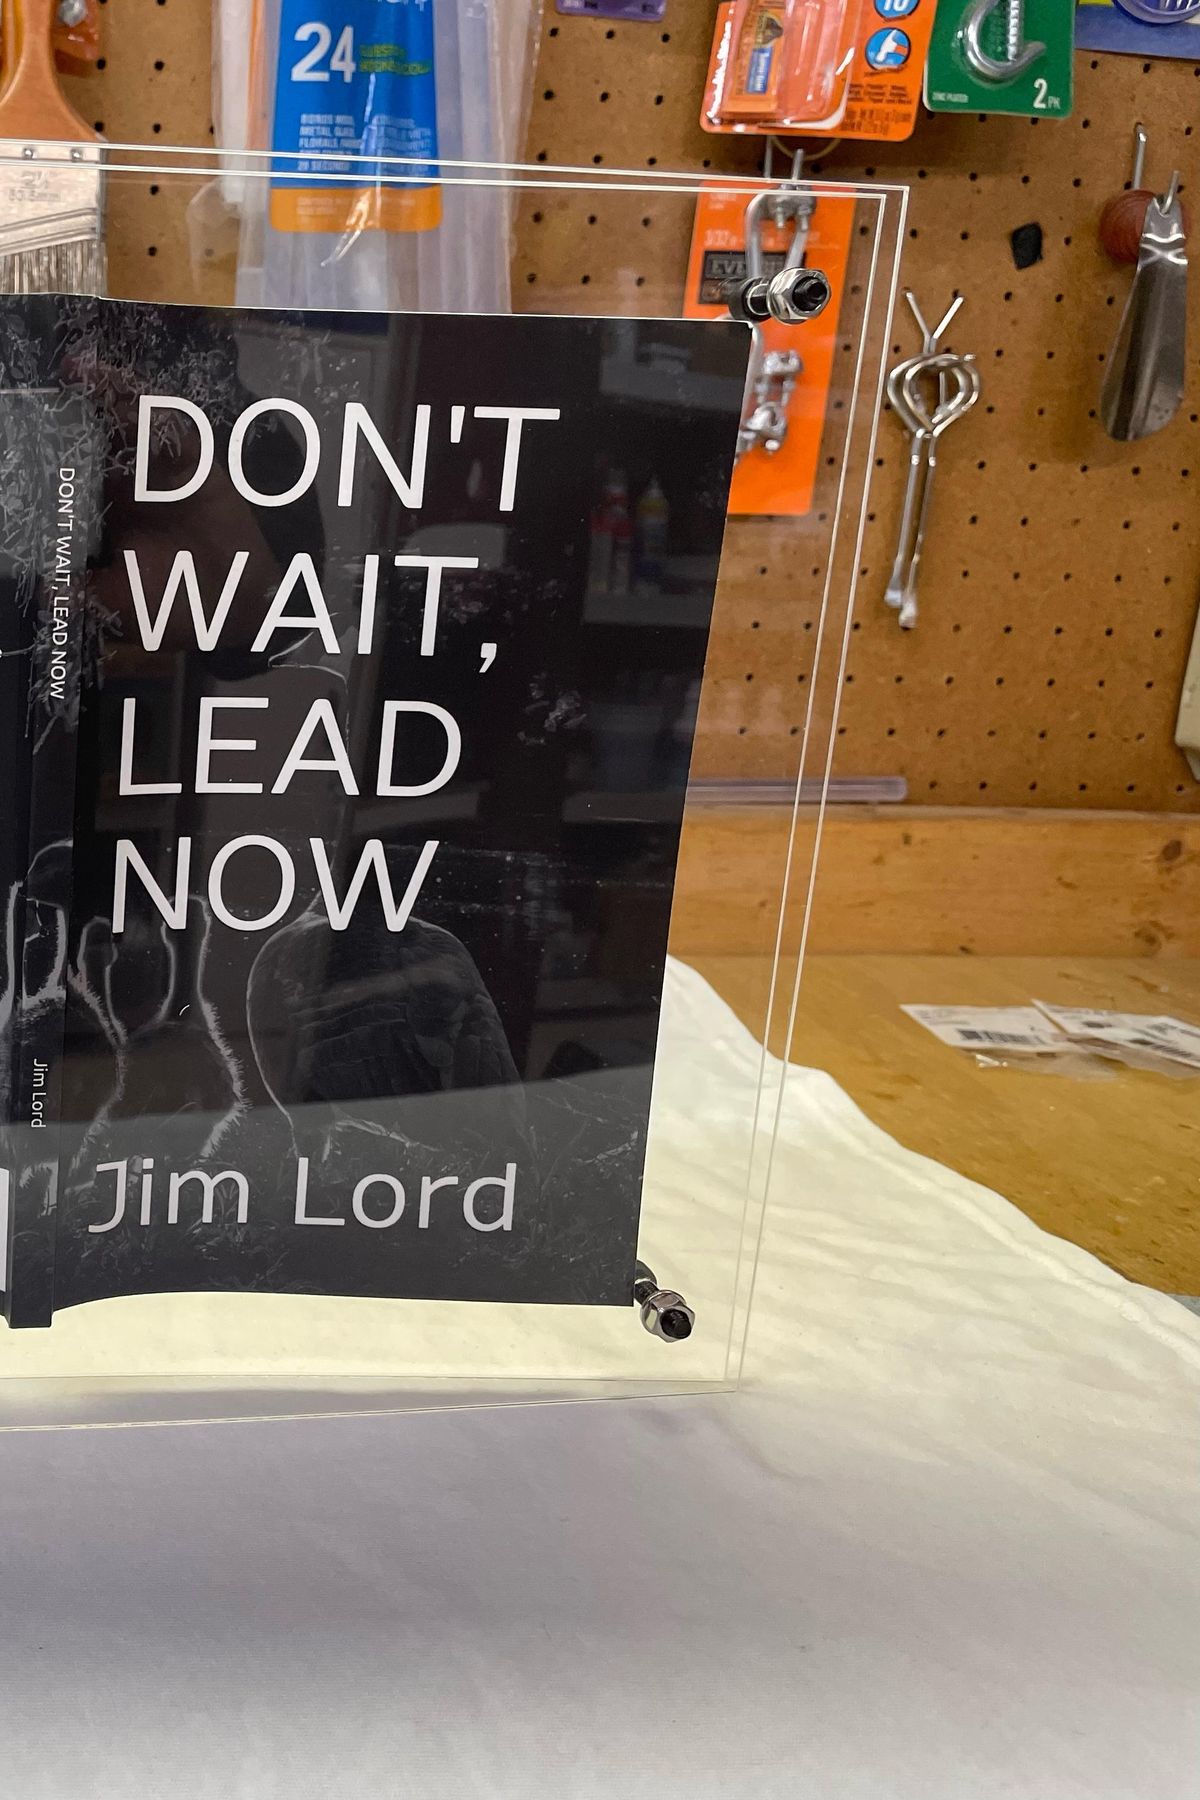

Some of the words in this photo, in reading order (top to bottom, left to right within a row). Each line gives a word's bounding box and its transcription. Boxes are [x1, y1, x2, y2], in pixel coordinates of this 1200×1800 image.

[290, 22, 356, 83] 24
[1033, 78, 1047, 109] 2
[134, 394, 561, 511] DON'T
[58, 468, 76, 531] DON'T
[51, 536, 72, 590] WAIT,
[52, 597, 70, 646] LEAD
[123, 549, 498, 673] WAIT,
[50, 651, 67, 700] NOW
[119, 697, 462, 797] LEAD
[112, 834, 439, 934] NOW
[33, 1058, 48, 1087] Jim
[31, 1092, 47, 1128] Lord
[88, 1157, 250, 1234] Jim
[294, 1157, 517, 1232] Lord
